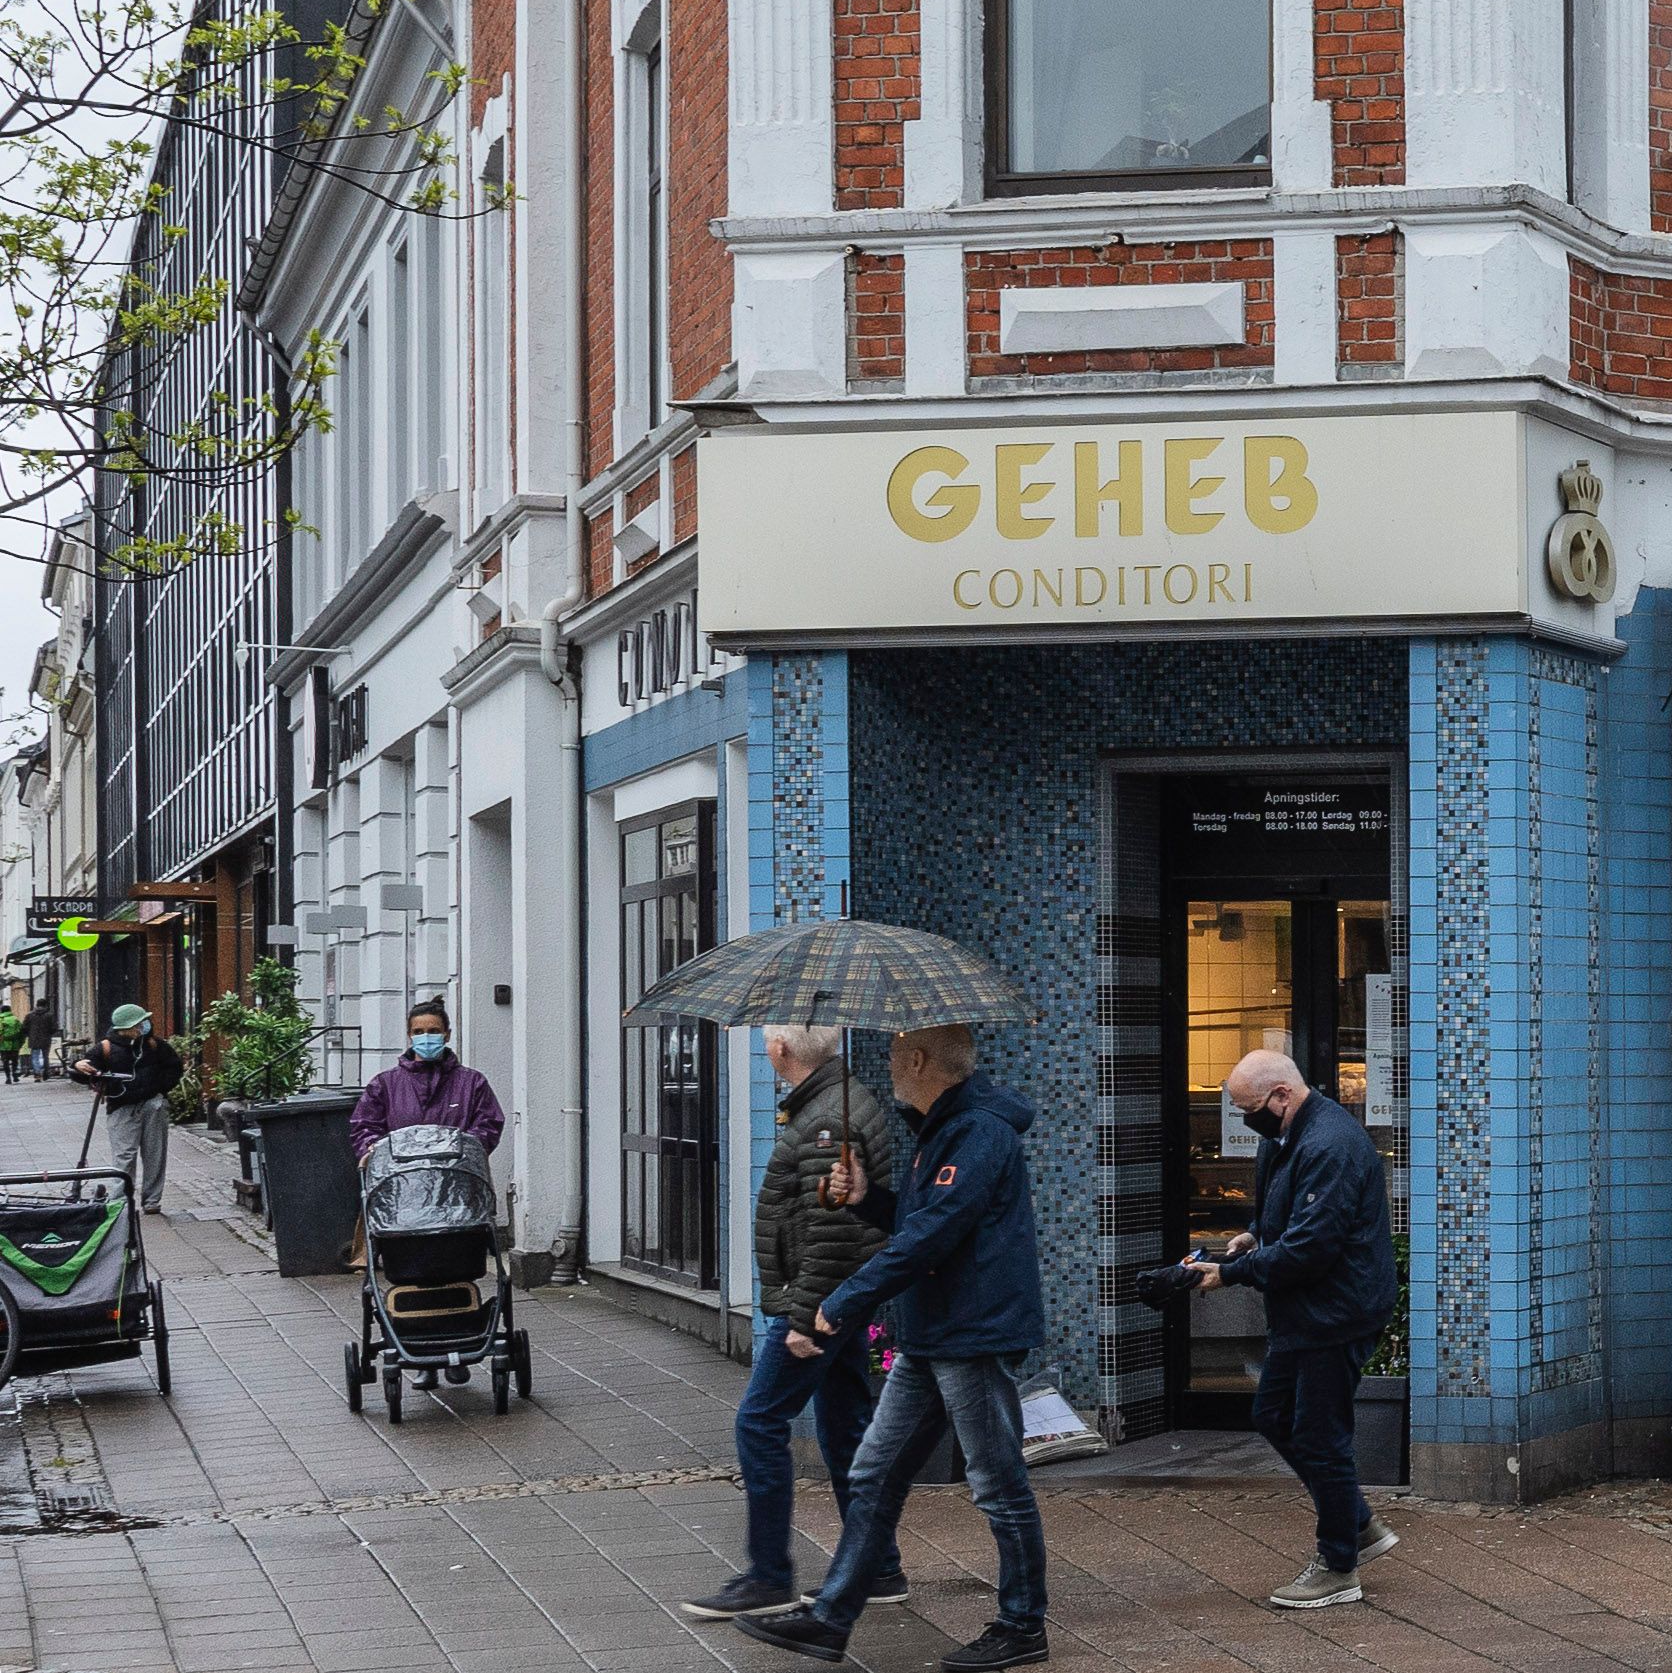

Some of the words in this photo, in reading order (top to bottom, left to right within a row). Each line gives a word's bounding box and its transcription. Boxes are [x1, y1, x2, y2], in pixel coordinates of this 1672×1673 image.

[886, 435, 1319, 543] GEHEB
[952, 562, 1253, 611] CONDITORI
[1193, 812, 1226, 822] Mandag
[1233, 812, 1261, 822] fredag
[1193, 823, 1227, 833] Torsdag
[34, 901, 48, 913] LA
[53, 901, 94, 913] SCARPA
